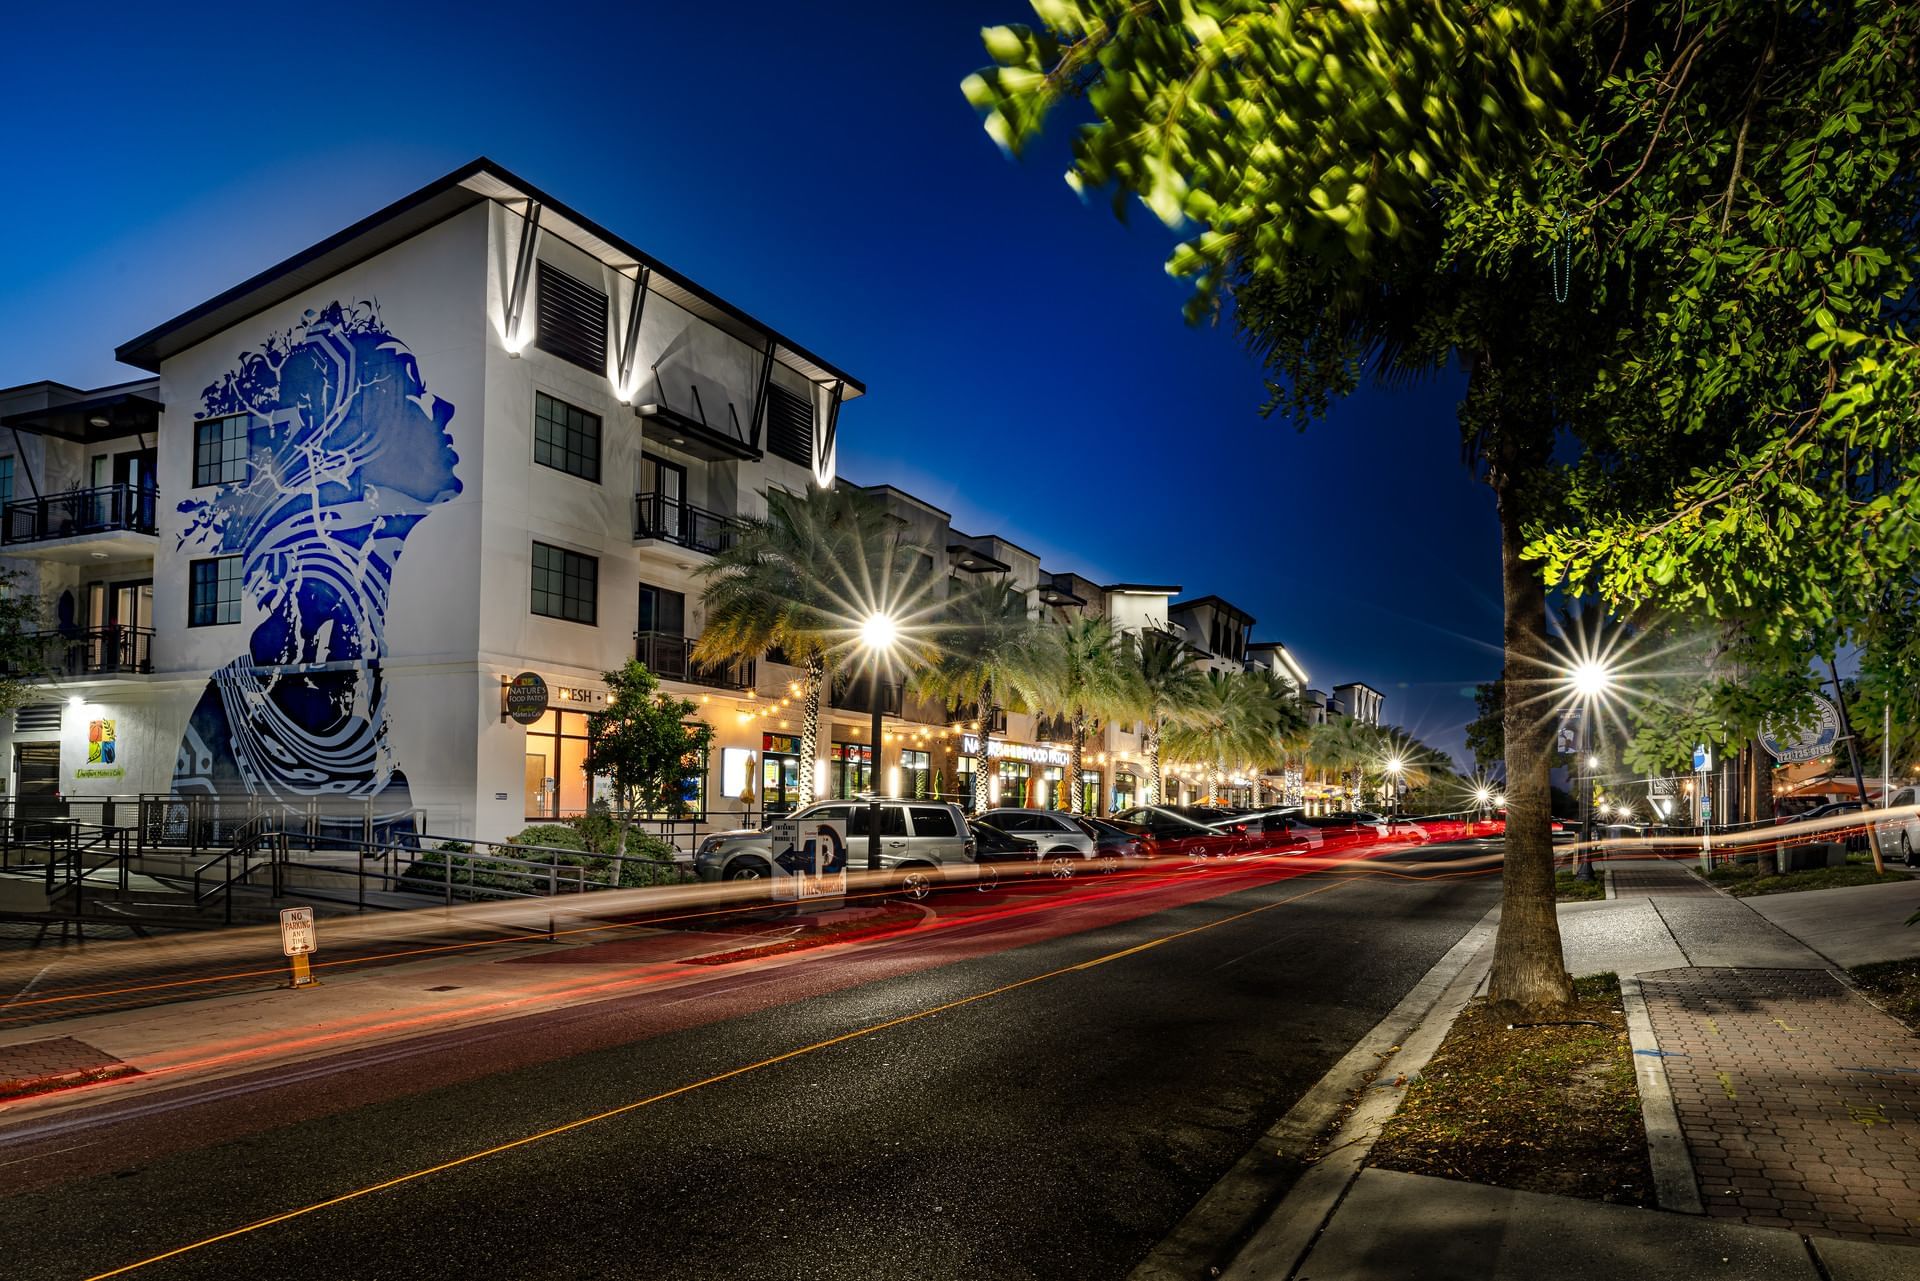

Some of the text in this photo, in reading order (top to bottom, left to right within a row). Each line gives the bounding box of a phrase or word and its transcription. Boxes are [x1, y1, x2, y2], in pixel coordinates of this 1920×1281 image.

[291, 912, 303, 921] NO
[285, 921, 311, 930] PARKING
[292, 930, 305, 938] ANY
[292, 937, 307, 945] TIME
